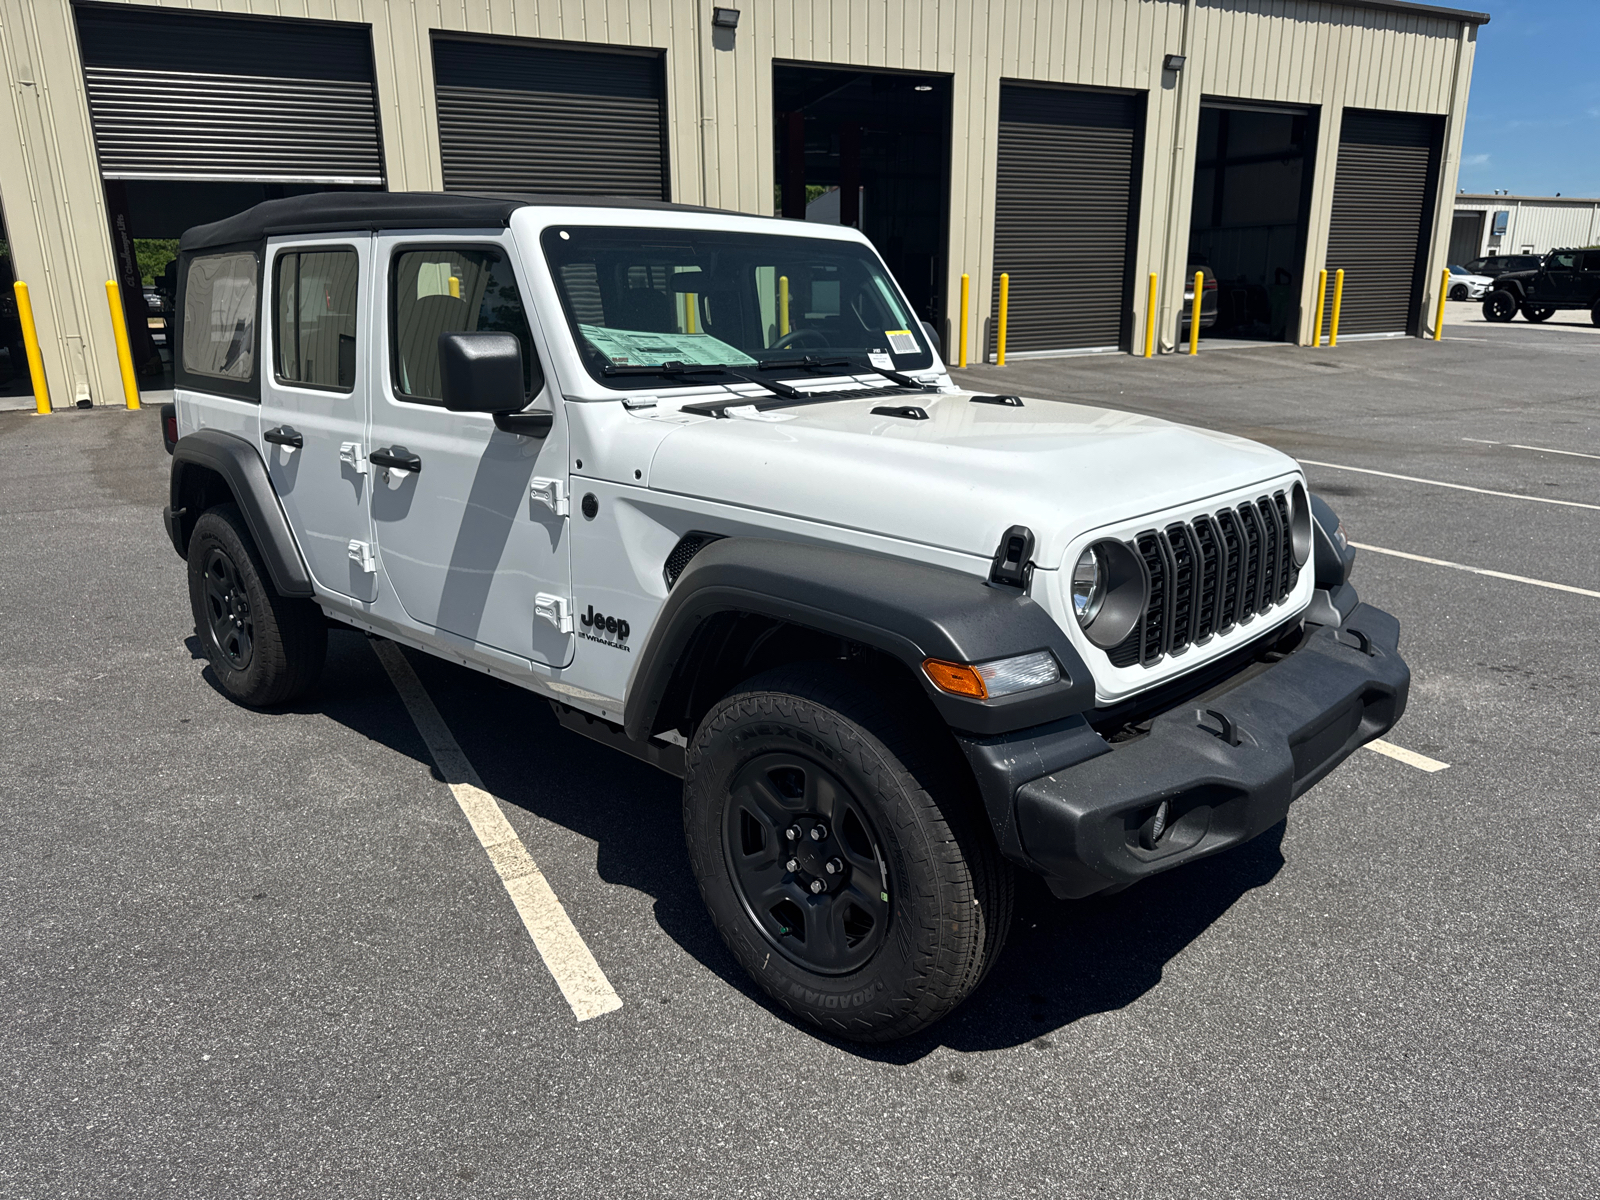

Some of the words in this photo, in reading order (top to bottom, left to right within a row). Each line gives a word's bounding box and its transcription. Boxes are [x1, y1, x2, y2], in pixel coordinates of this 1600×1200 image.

[116, 214, 126, 231] Lifts
[120, 231, 133, 275] Challenger
[581, 604, 630, 641] Jeep
[585, 633, 631, 653] WRANGLER
[740, 724, 834, 760] NEXEN
[788, 982, 876, 1008] ROADIAN
